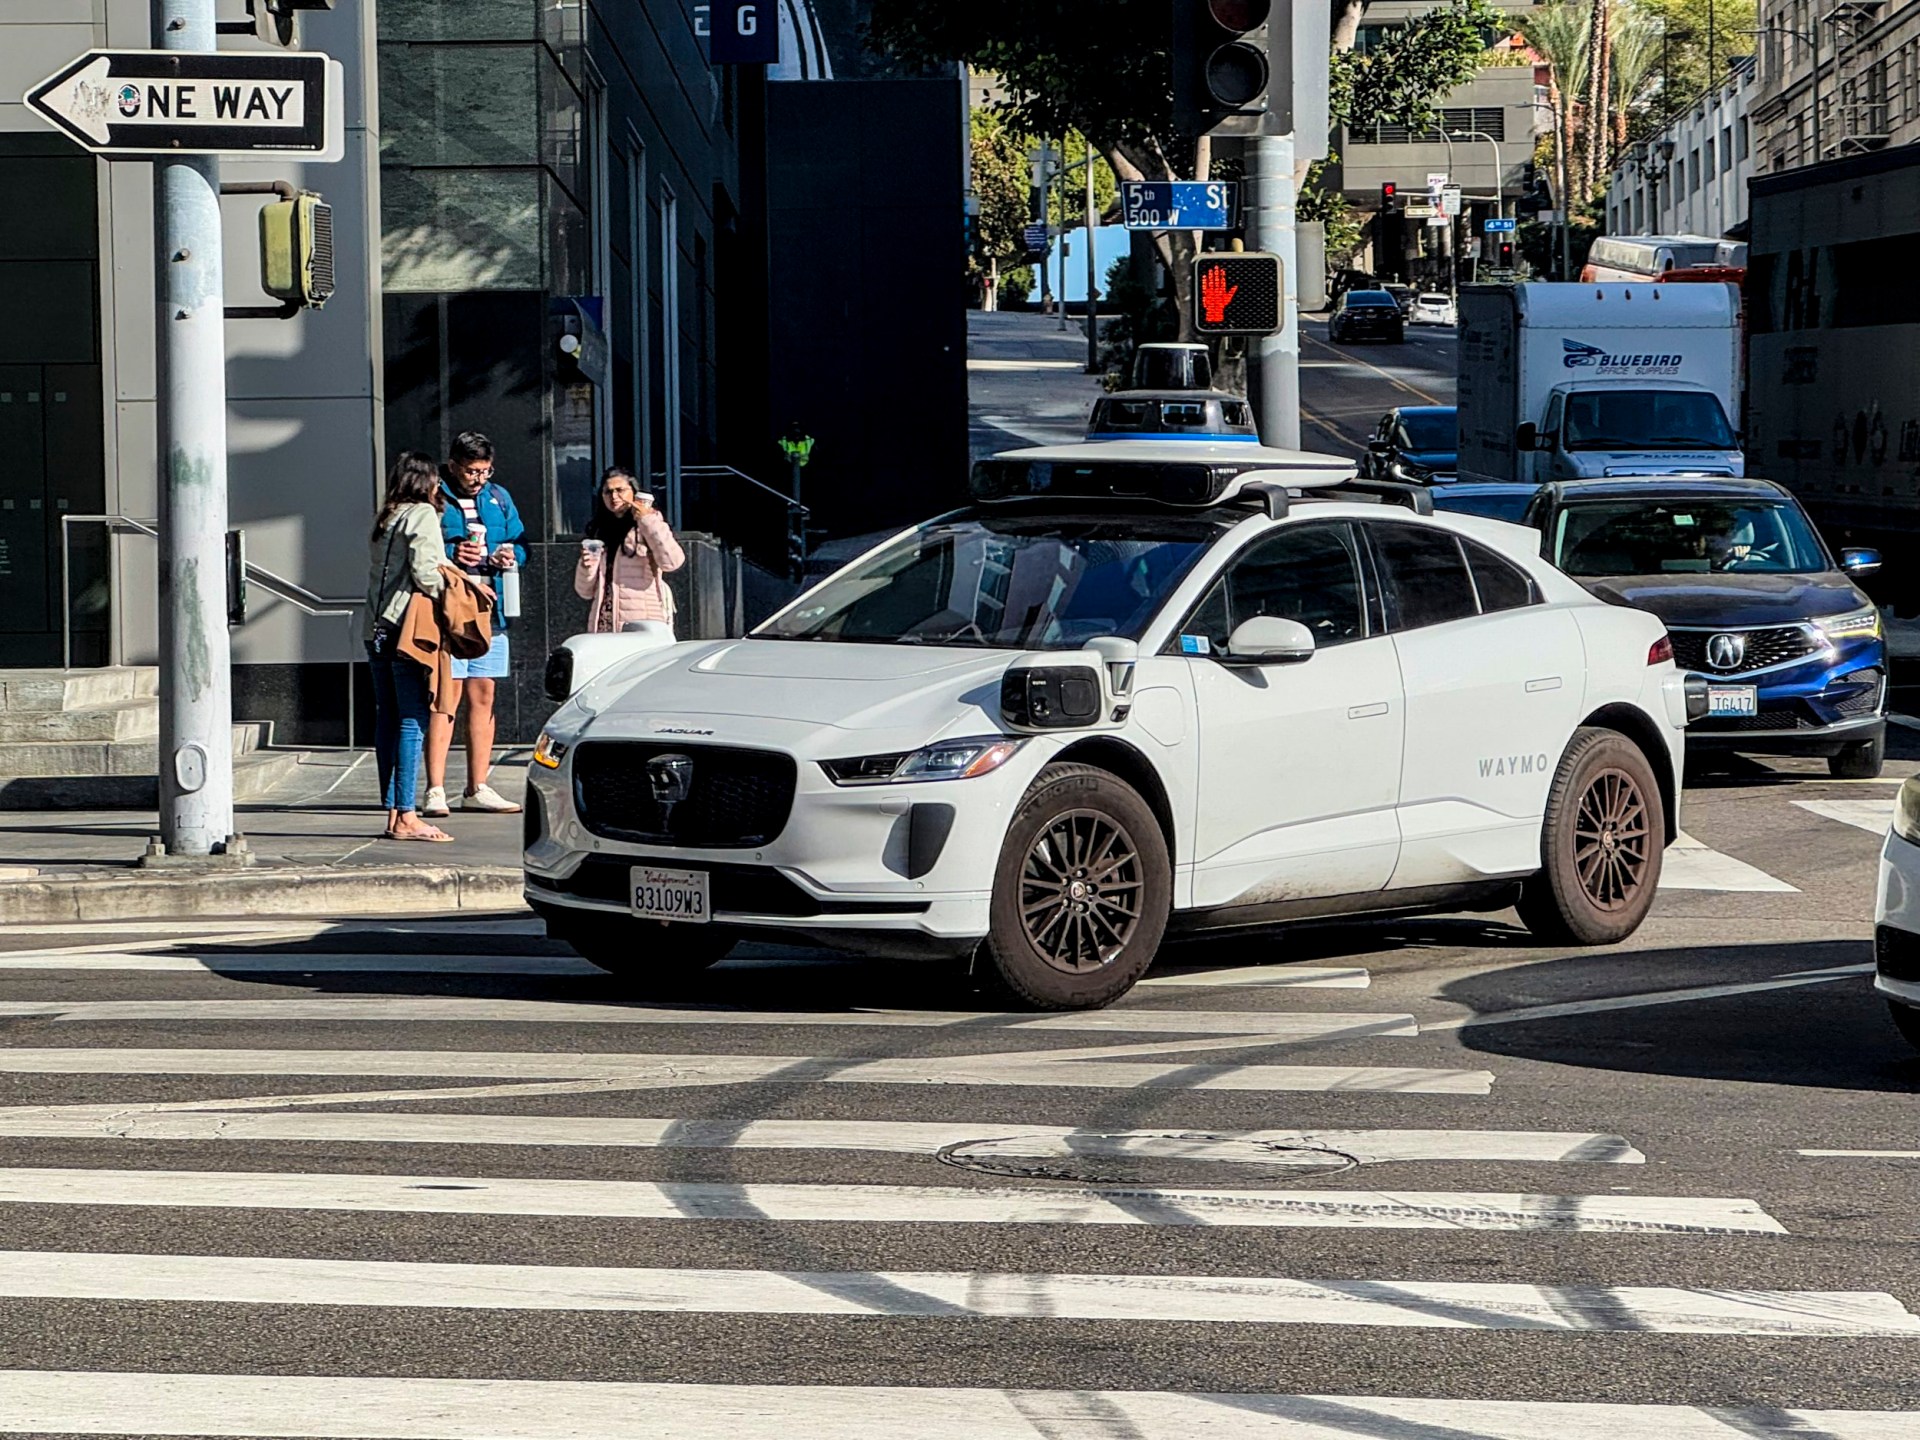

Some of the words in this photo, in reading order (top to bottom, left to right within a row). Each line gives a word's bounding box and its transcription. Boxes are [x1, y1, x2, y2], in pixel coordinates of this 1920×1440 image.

[737, 5, 757, 36] G
[118, 84, 197, 118] ONE
[213, 86, 294, 120] WAY
[1129, 185, 1156, 209] 5th
[1206, 185, 1230, 209] St
[1129, 209, 1160, 226] 500
[1167, 209, 1180, 226] W
[1595, 366, 1630, 375] OFFICE
[1635, 366, 1680, 375] SUPPLIES
[1599, 354, 1683, 367] BLUEBIRD
[654, 728, 715, 736] JAGUAR
[1478, 753, 1548, 778] WAYMO
